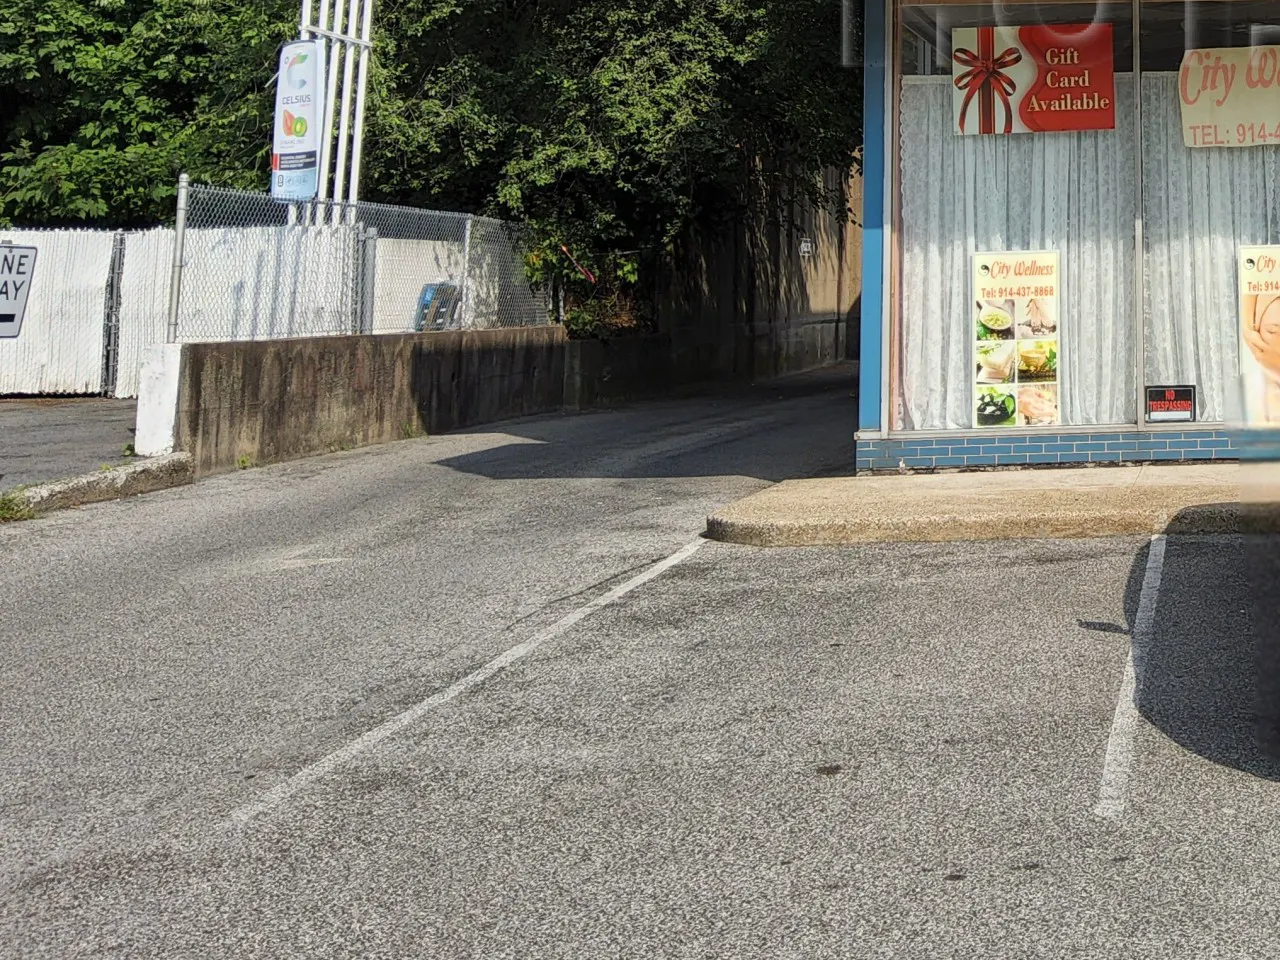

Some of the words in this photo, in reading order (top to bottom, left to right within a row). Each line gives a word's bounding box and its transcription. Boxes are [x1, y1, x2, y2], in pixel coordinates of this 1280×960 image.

[1046, 47, 1079, 65] Gift
[1046, 70, 1090, 88] Card
[1180, 51, 1236, 107] City
[282, 95, 311, 105] CELSIUS
[1027, 93, 1110, 112] Available
[1189, 125, 1230, 145] TEL:
[0, 254, 29, 275] NE
[990, 261, 1011, 279] City
[1014, 260, 1054, 276] Wellness
[1257, 255, 1276, 273] City
[0, 280, 25, 300] AY
[981, 287, 996, 298] Tel:
[998, 286, 1054, 297] 914-437-8868
[1248, 281, 1263, 292] Tel:
[1165, 389, 1176, 401] NO
[1149, 400, 1192, 412] TRESPASSING
